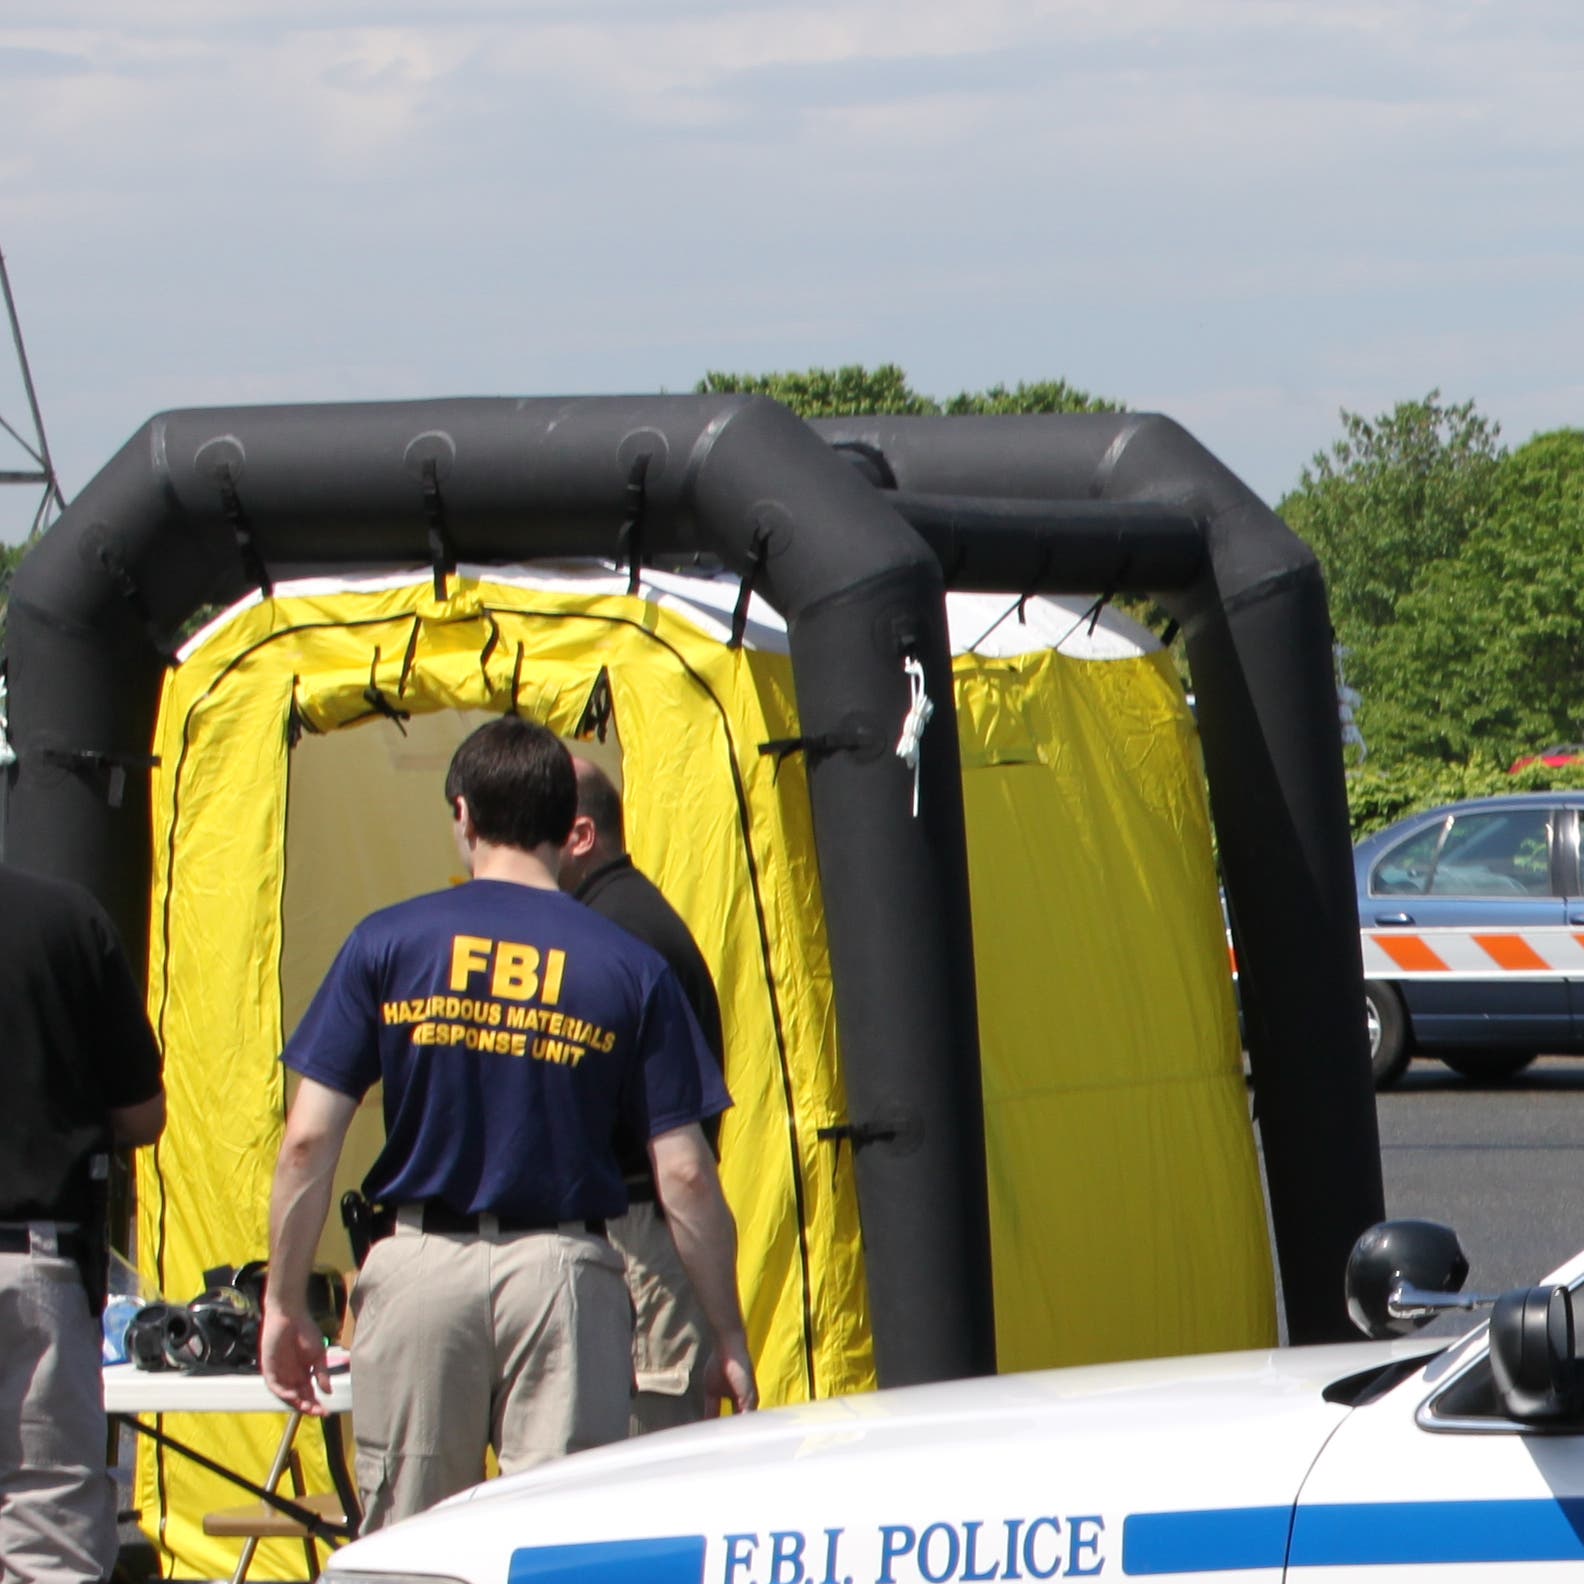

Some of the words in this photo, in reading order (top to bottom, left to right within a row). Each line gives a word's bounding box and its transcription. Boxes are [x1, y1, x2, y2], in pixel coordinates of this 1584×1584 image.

[450, 935, 566, 1006] FBI
[506, 1006, 616, 1053] MATERIALS
[532, 1038, 586, 1068] UNIT
